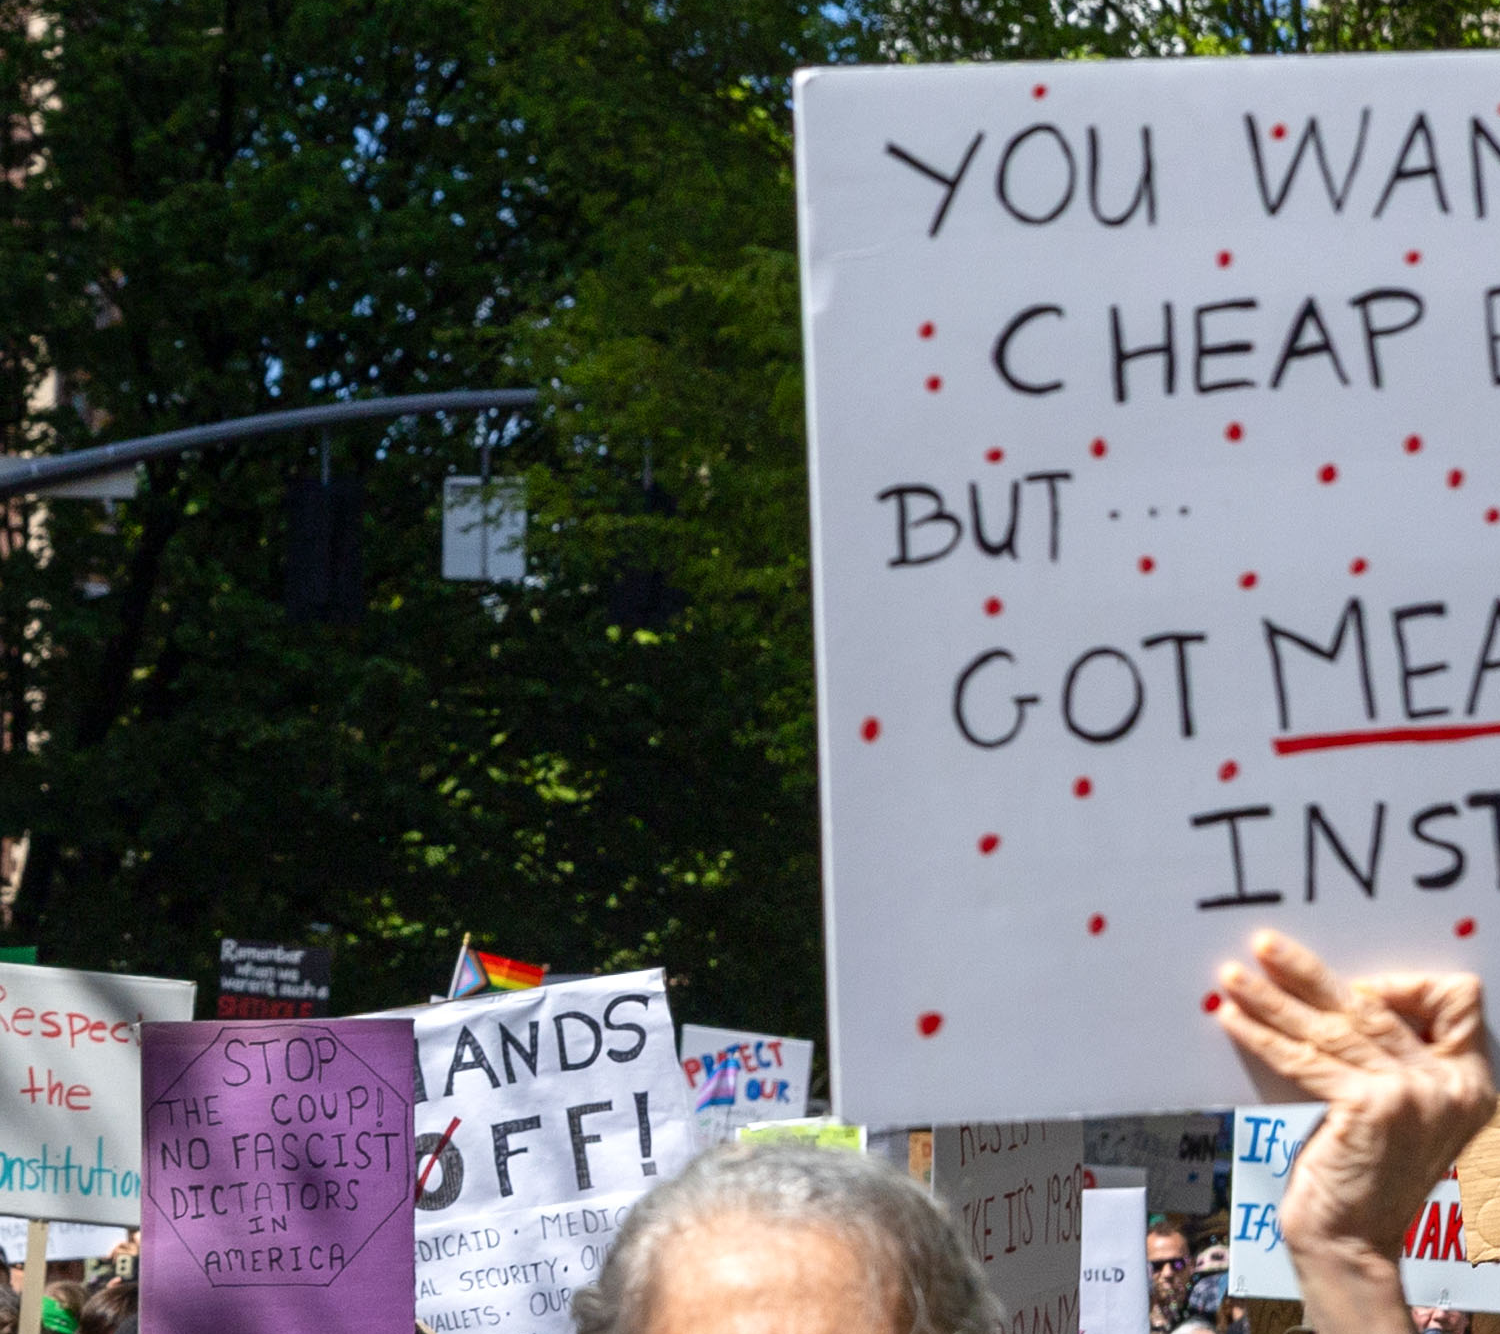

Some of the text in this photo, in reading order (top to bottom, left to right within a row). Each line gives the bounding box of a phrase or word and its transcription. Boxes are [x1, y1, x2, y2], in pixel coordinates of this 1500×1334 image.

[885, 121, 1157, 238] YOU
[991, 285, 1426, 404] CHEAP
[952, 634, 1207, 749] GOT
[222, 1036, 338, 1087] STOP
[20, 1065, 92, 1111] the
[156, 1085, 385, 1129] THE COUP!
[745, 1077, 790, 1105] OUR
[160, 1130, 401, 1173] NO FASCIST
[170, 1178, 360, 1221] DICTATORS
[248, 1214, 288, 1235] IN
[204, 1242, 346, 1274] AMERICA
[415, 1228, 501, 1265] DICAID
[1084, 1267, 1126, 1283] UILD
